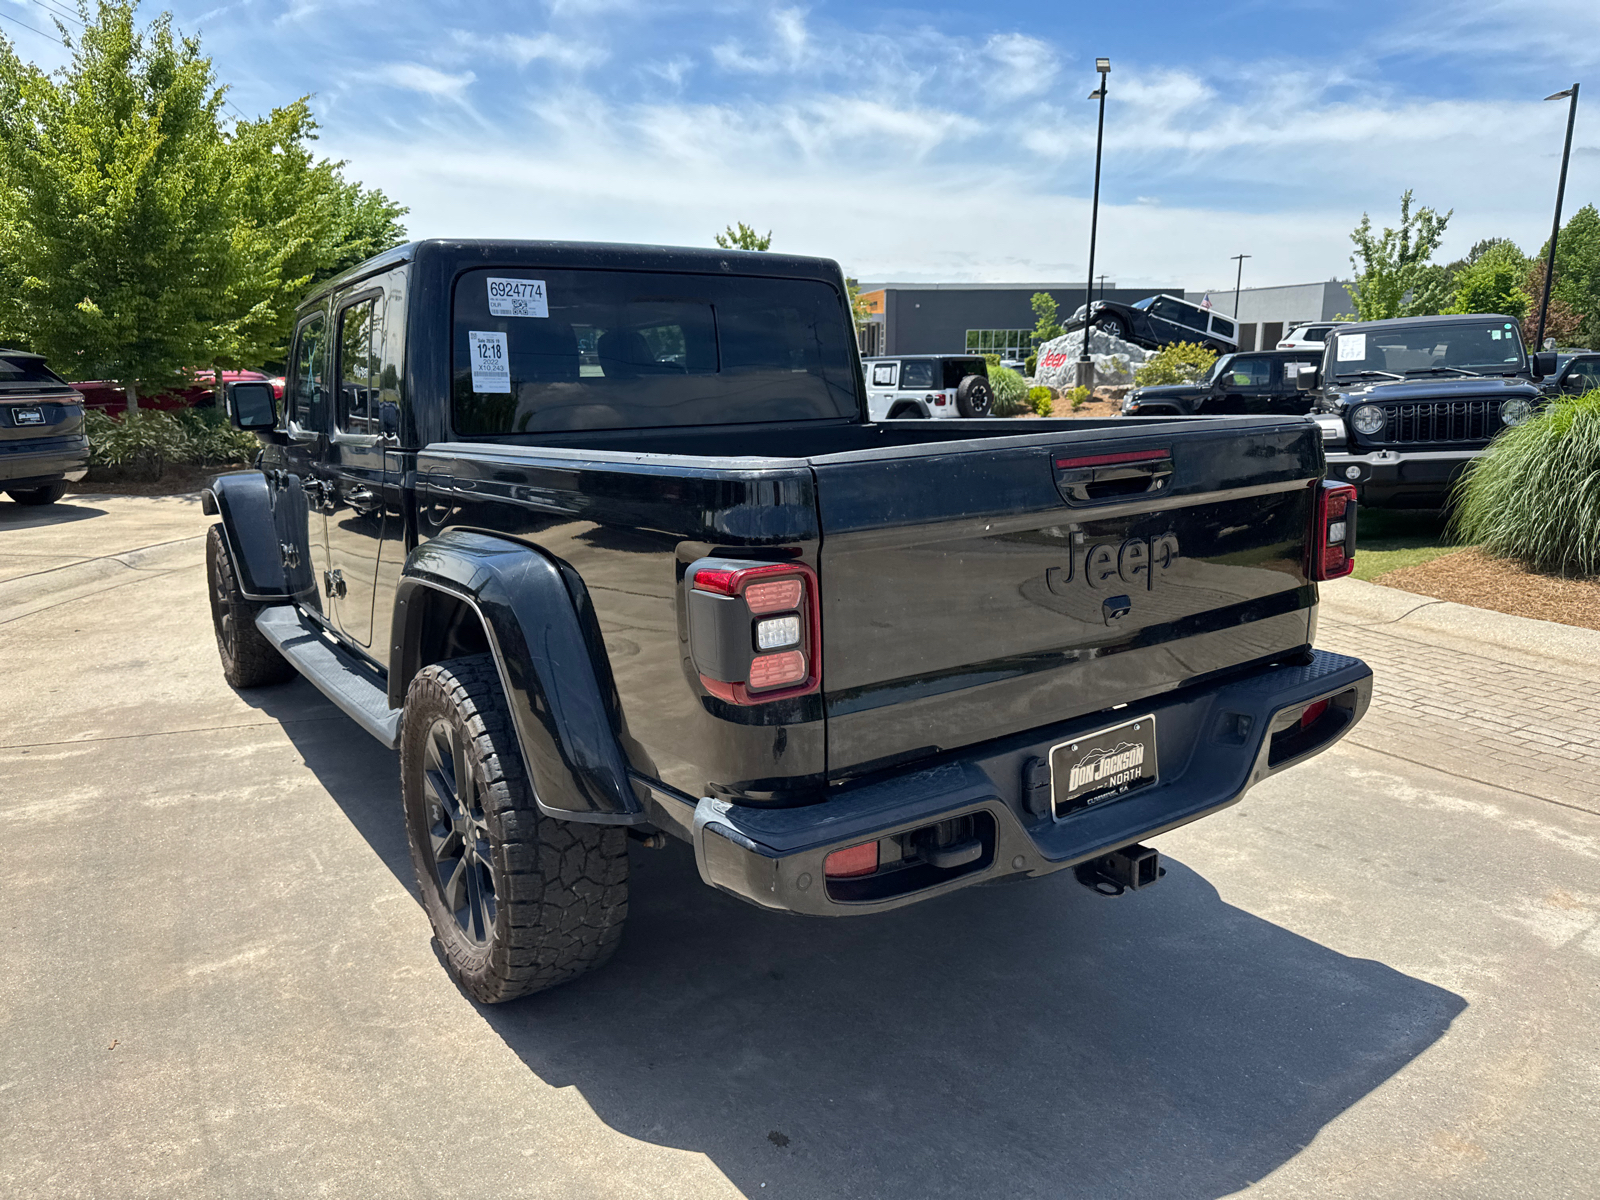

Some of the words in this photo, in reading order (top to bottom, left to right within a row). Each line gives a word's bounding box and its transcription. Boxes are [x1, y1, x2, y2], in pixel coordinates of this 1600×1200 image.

[490, 281, 543, 299] 6924774
[477, 343, 502, 359] 12:18
[1040, 349, 1067, 371] Jeep
[1045, 530, 1180, 596] Jeep
[1068, 763, 1095, 792] DON
[1094, 745, 1145, 781] JACKSON
[1109, 766, 1142, 788] NORTH
